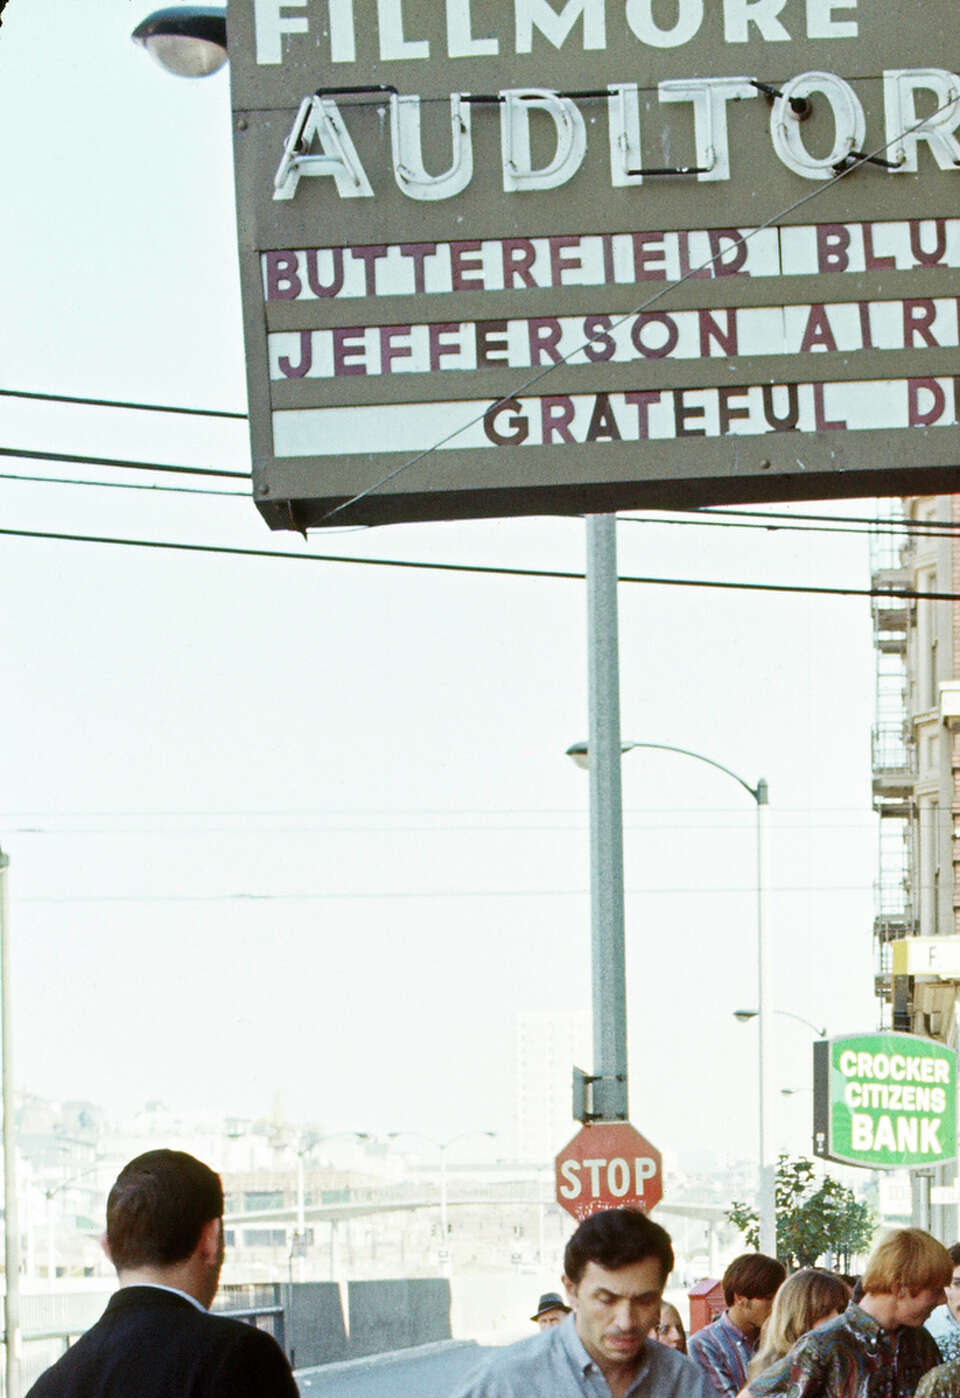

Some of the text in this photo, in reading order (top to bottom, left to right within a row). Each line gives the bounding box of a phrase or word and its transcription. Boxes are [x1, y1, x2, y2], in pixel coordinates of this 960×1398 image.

[266, 228, 750, 300] BUTTERFIELD
[278, 308, 738, 379] JEFFERSON
[483, 383, 847, 446] GRATEFUL
[839, 1050, 951, 1084] CROCKER
[844, 1081, 947, 1113] CITIZENS
[851, 1113, 943, 1154] BANK
[560, 1157, 657, 1199] STOP
